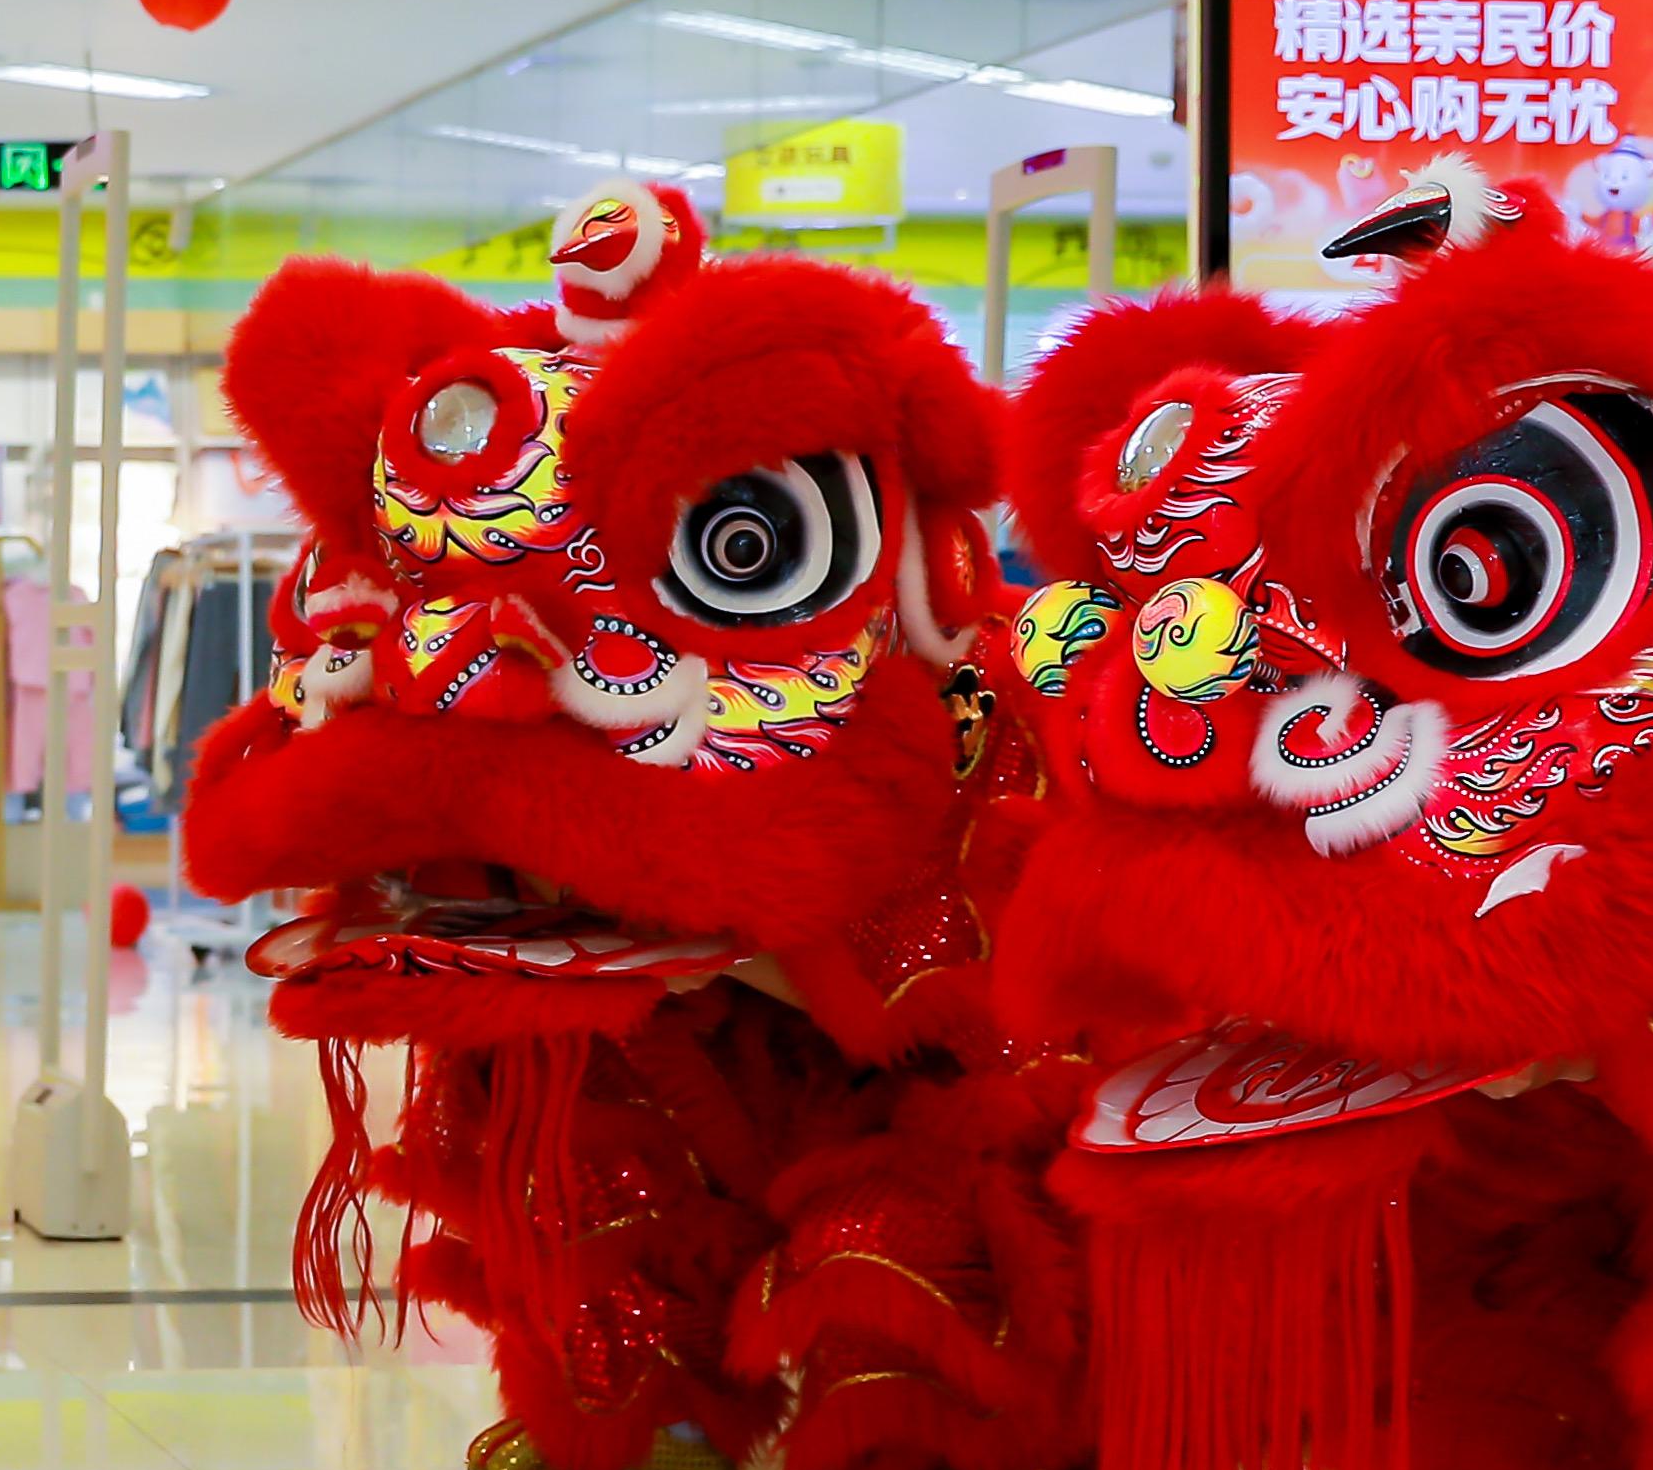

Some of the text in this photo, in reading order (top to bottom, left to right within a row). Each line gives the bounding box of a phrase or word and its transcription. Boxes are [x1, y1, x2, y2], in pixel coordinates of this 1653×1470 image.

[1276, 74, 1620, 145] 安心购无忧
